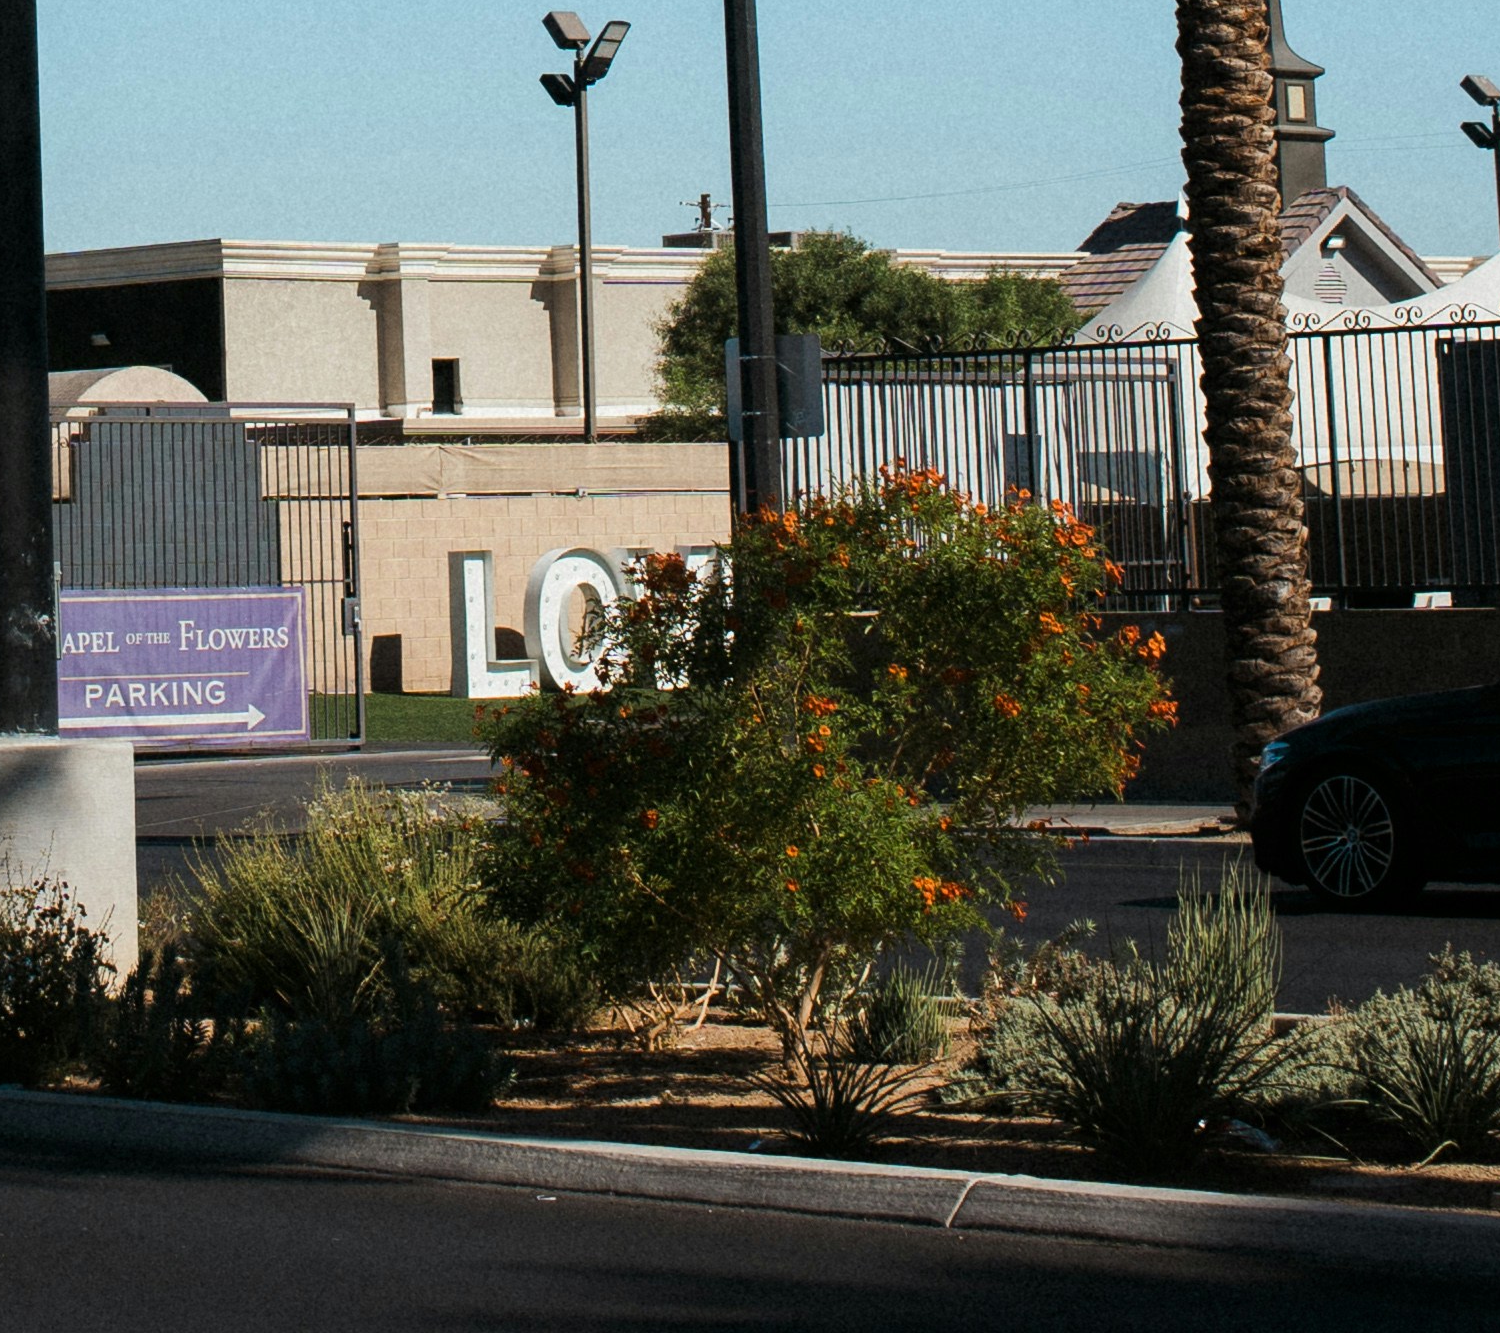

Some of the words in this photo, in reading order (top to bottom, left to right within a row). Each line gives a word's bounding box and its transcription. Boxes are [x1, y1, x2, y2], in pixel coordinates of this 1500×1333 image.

[62, 631, 120, 654] APEL
[126, 633, 143, 645] OF
[145, 632, 171, 644] THE
[178, 620, 289, 651] FLOWERS
[85, 680, 226, 709] PARKING
